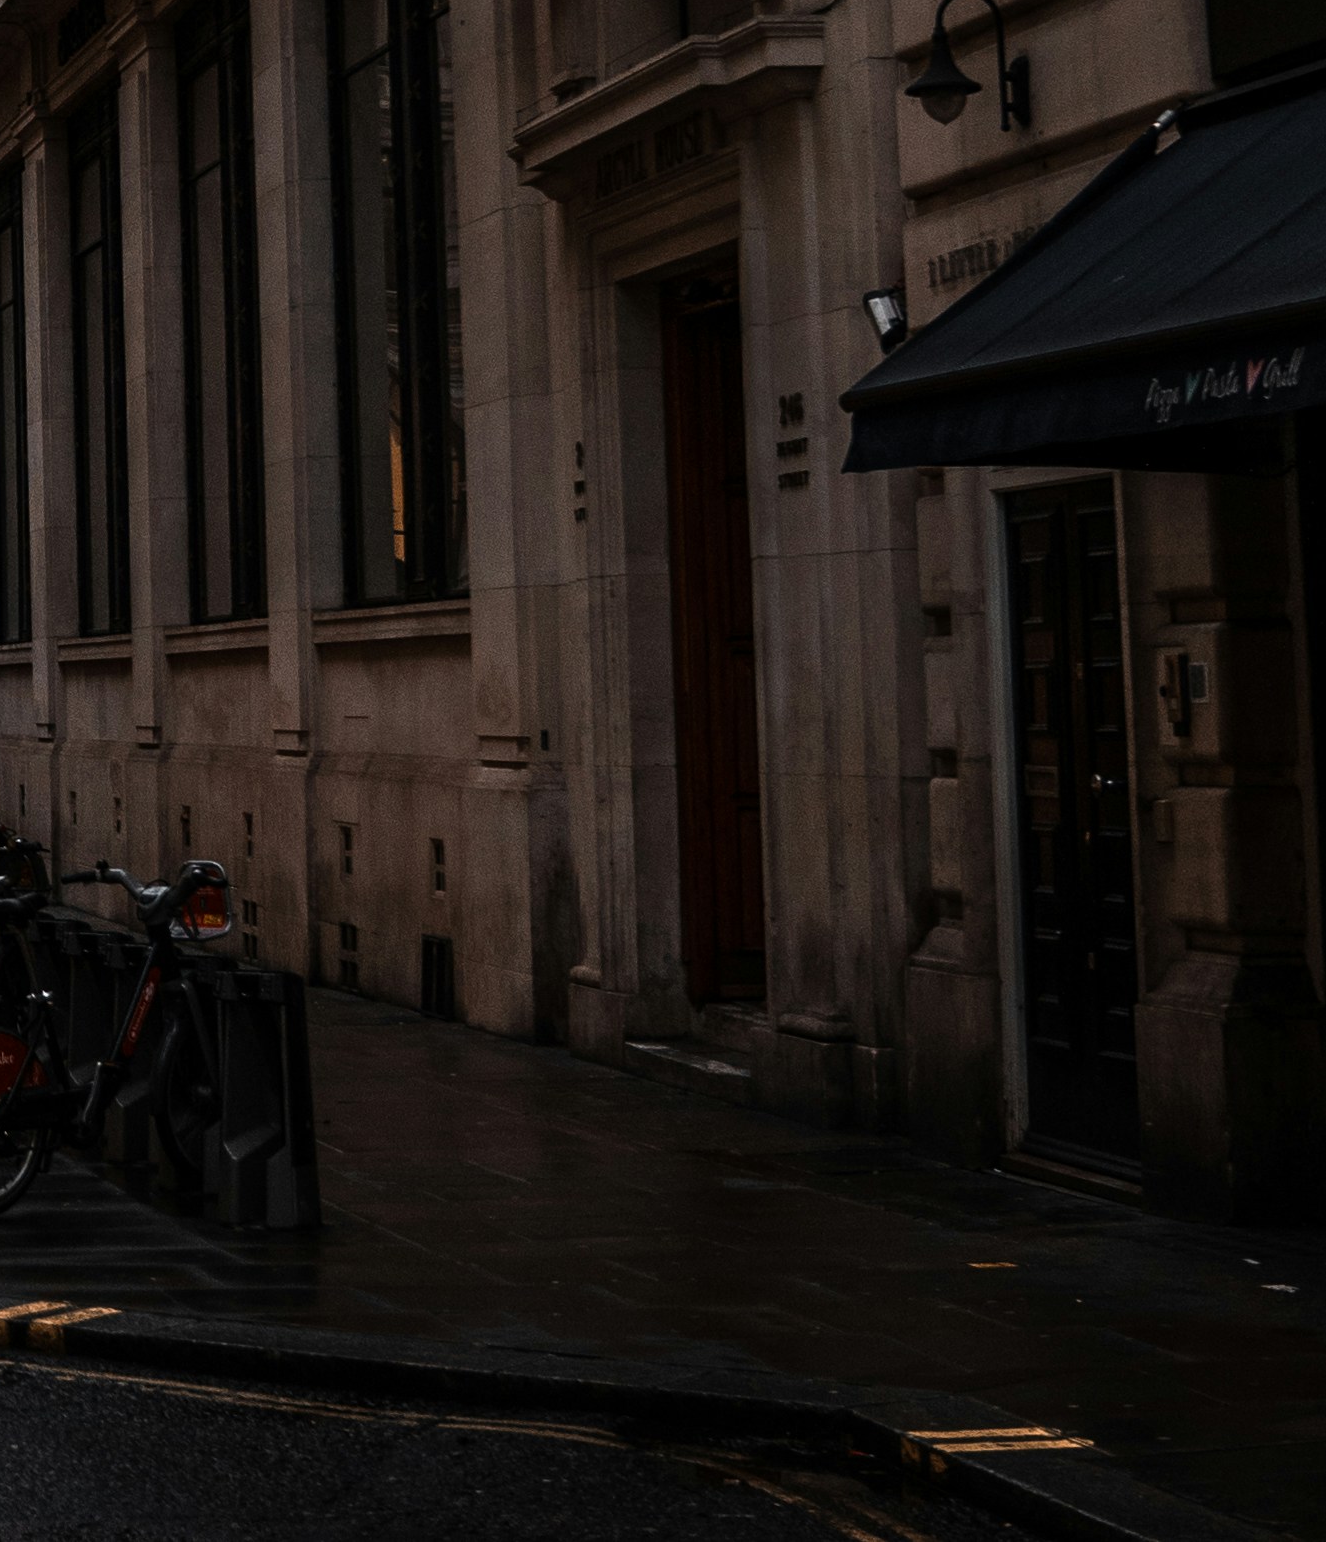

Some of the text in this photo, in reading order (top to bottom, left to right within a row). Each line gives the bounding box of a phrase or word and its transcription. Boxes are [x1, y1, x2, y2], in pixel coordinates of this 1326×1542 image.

[654, 109, 703, 174] HOUSE
[1201, 361, 1240, 401] Pasta
[1262, 346, 1306, 400] Grill
